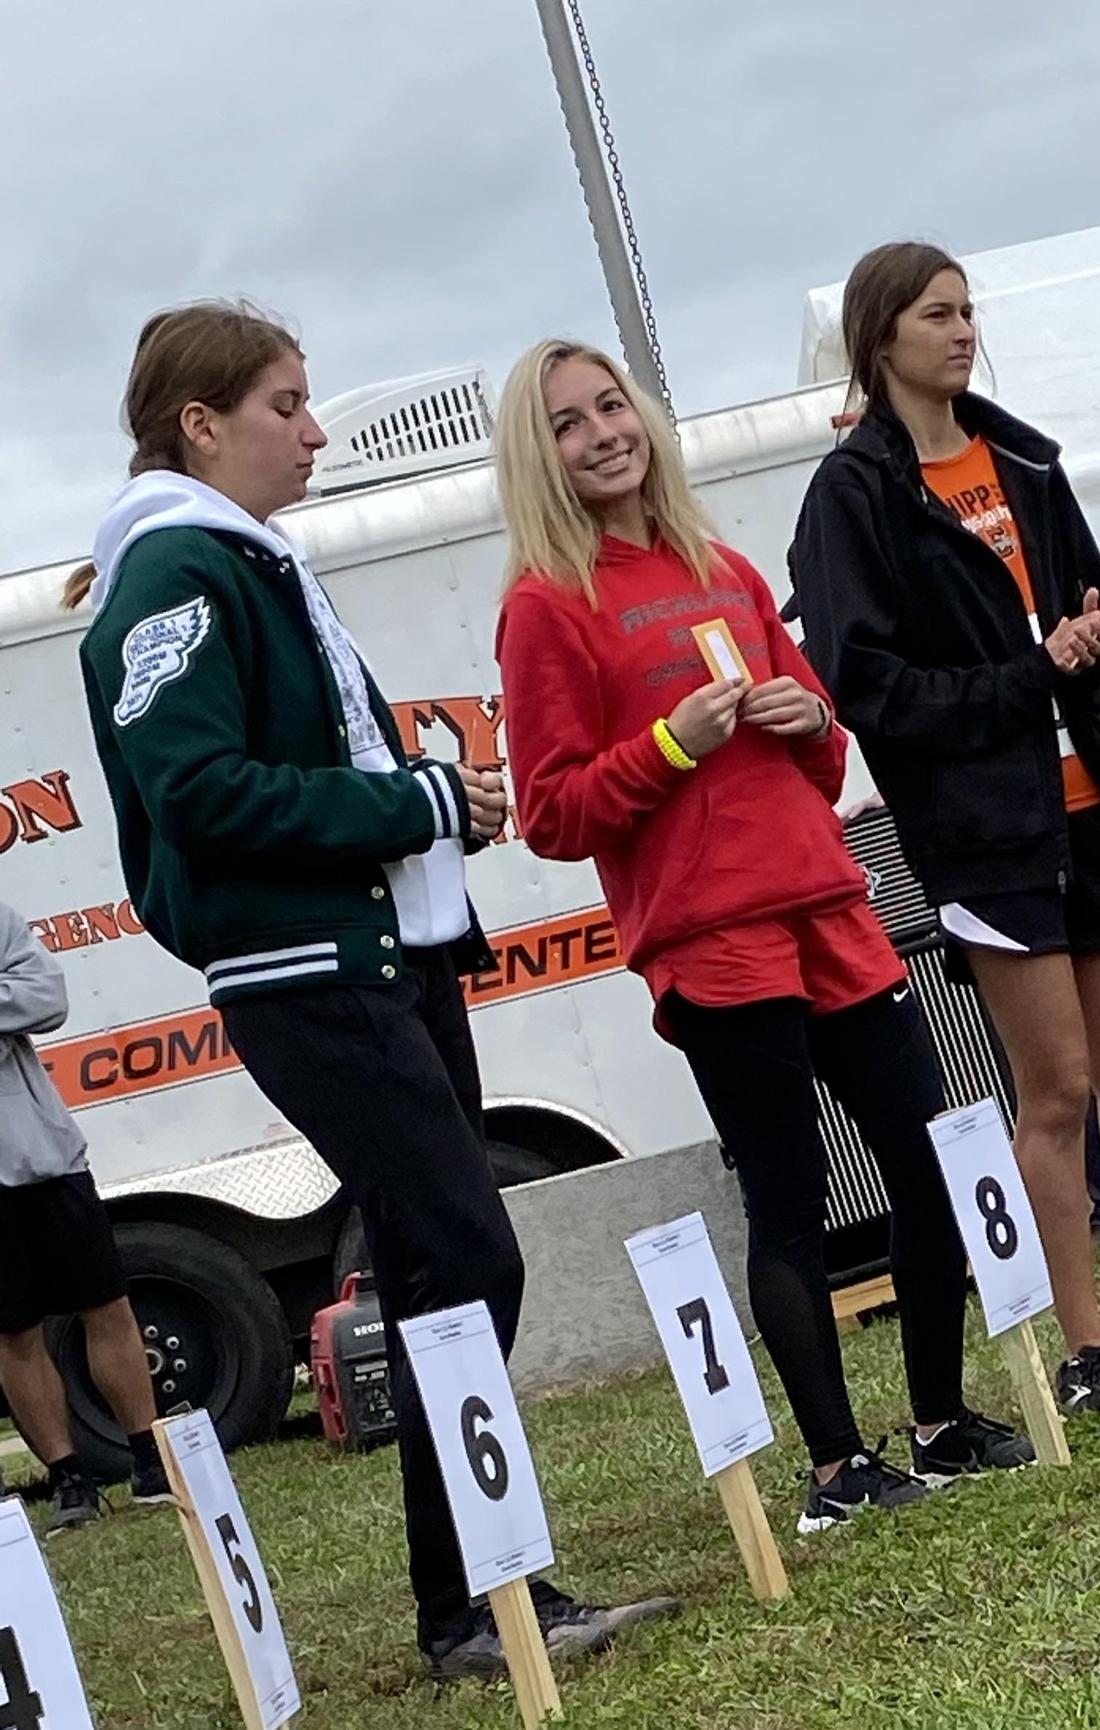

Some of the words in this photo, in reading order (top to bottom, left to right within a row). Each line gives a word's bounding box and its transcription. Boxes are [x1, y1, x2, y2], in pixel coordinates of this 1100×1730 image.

[975, 1175, 1018, 1260] 8
[676, 1297, 731, 1396] 7
[461, 1395, 509, 1501] 6
[215, 1513, 263, 1634] 5
